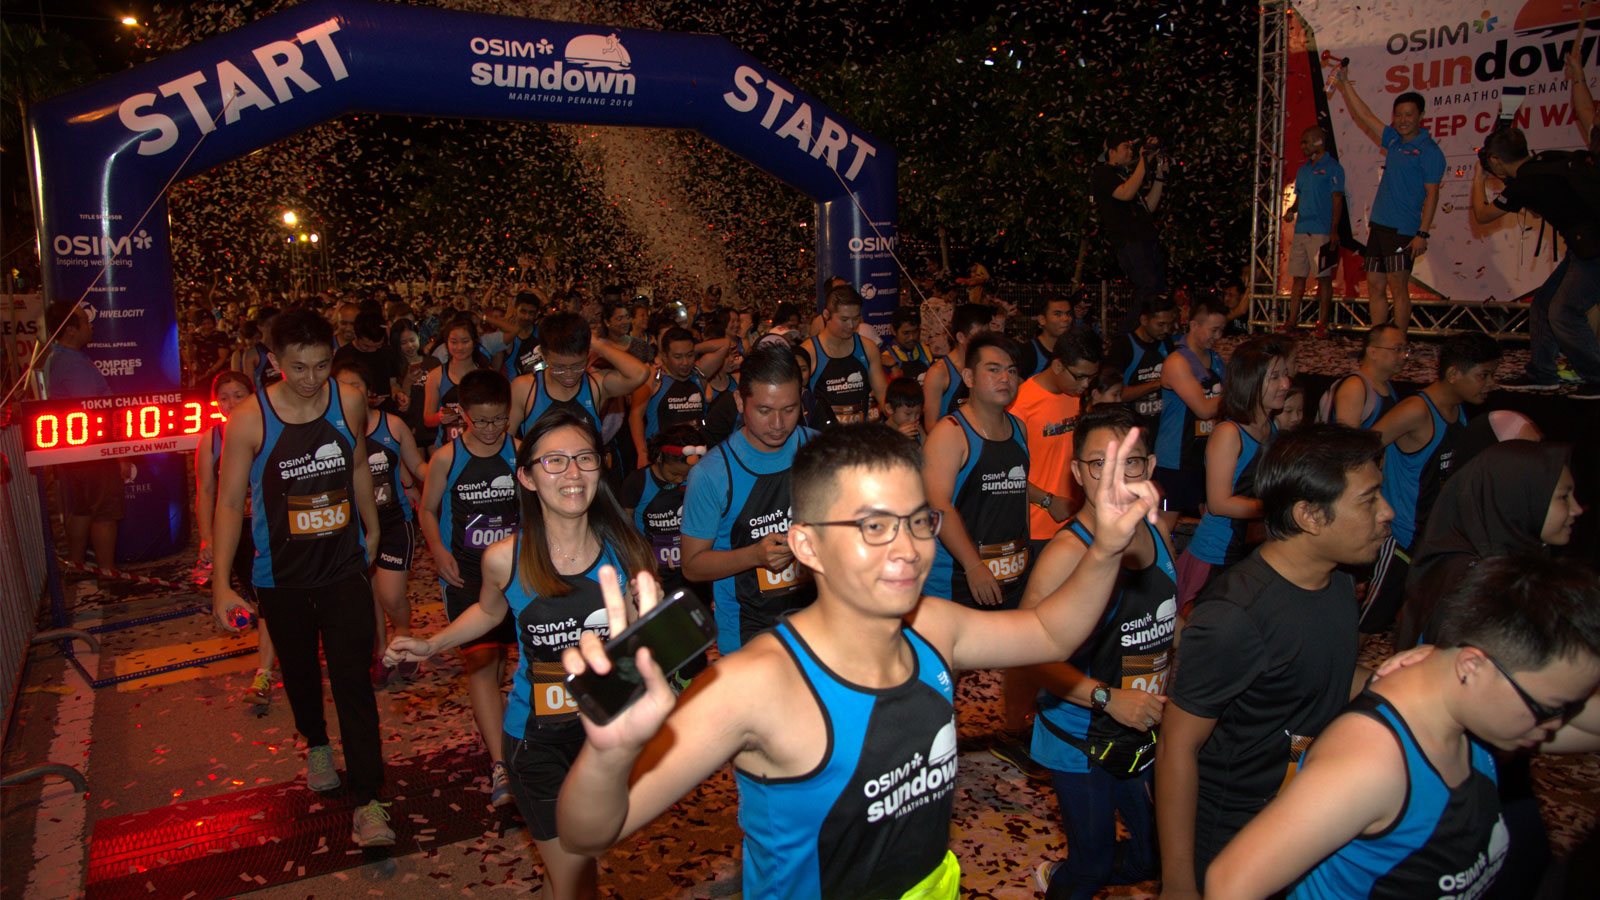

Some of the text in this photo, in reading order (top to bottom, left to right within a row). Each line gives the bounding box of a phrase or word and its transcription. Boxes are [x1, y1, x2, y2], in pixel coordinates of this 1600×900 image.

[1386, 21, 1469, 55] OSIM
[470, 37, 536, 59] OSIM
[1384, 36, 1600, 94] sundow
[118, 19, 349, 156] START
[470, 61, 636, 95] sundown
[508, 92, 563, 103] MARATHON
[567, 96, 606, 106] PENANG
[1433, 80, 1569, 106] MARATHO ENAN
[723, 65, 877, 182] START
[1421, 115, 1467, 138] EEP
[1474, 107, 1531, 133] CN
[54, 234, 132, 256] OSIM
[848, 236, 895, 252] OSIM
[56, 258, 89, 268] Inspiring
[99, 308, 145, 318] HIVELOCITY
[94, 358, 143, 369] OMPRES
[826, 382, 864, 391] sundown
[81, 393, 182, 410] 10KM CHALLENGE
[101, 441, 177, 457] SLEEP CAN WAIT
[279, 457, 305, 469] OSIM
[281, 456, 346, 480] sundown
[457, 482, 481, 491] OSIM
[982, 473, 1001, 481] OSIM
[458, 488, 515, 501] sundown
[296, 505, 346, 530] 0536
[648, 516, 682, 527] sundo
[749, 513, 776, 527] OSIM
[750, 518, 793, 539] sund
[660, 547, 681, 561] 00
[988, 553, 1025, 577] 0565
[527, 621, 565, 634] OSIM
[1120, 618, 1148, 632] OSIM
[1120, 617, 1177, 647] sundow
[864, 762, 911, 798] OSIM
[867, 755, 958, 823] sundow
[1438, 861, 1481, 892] OSIM
